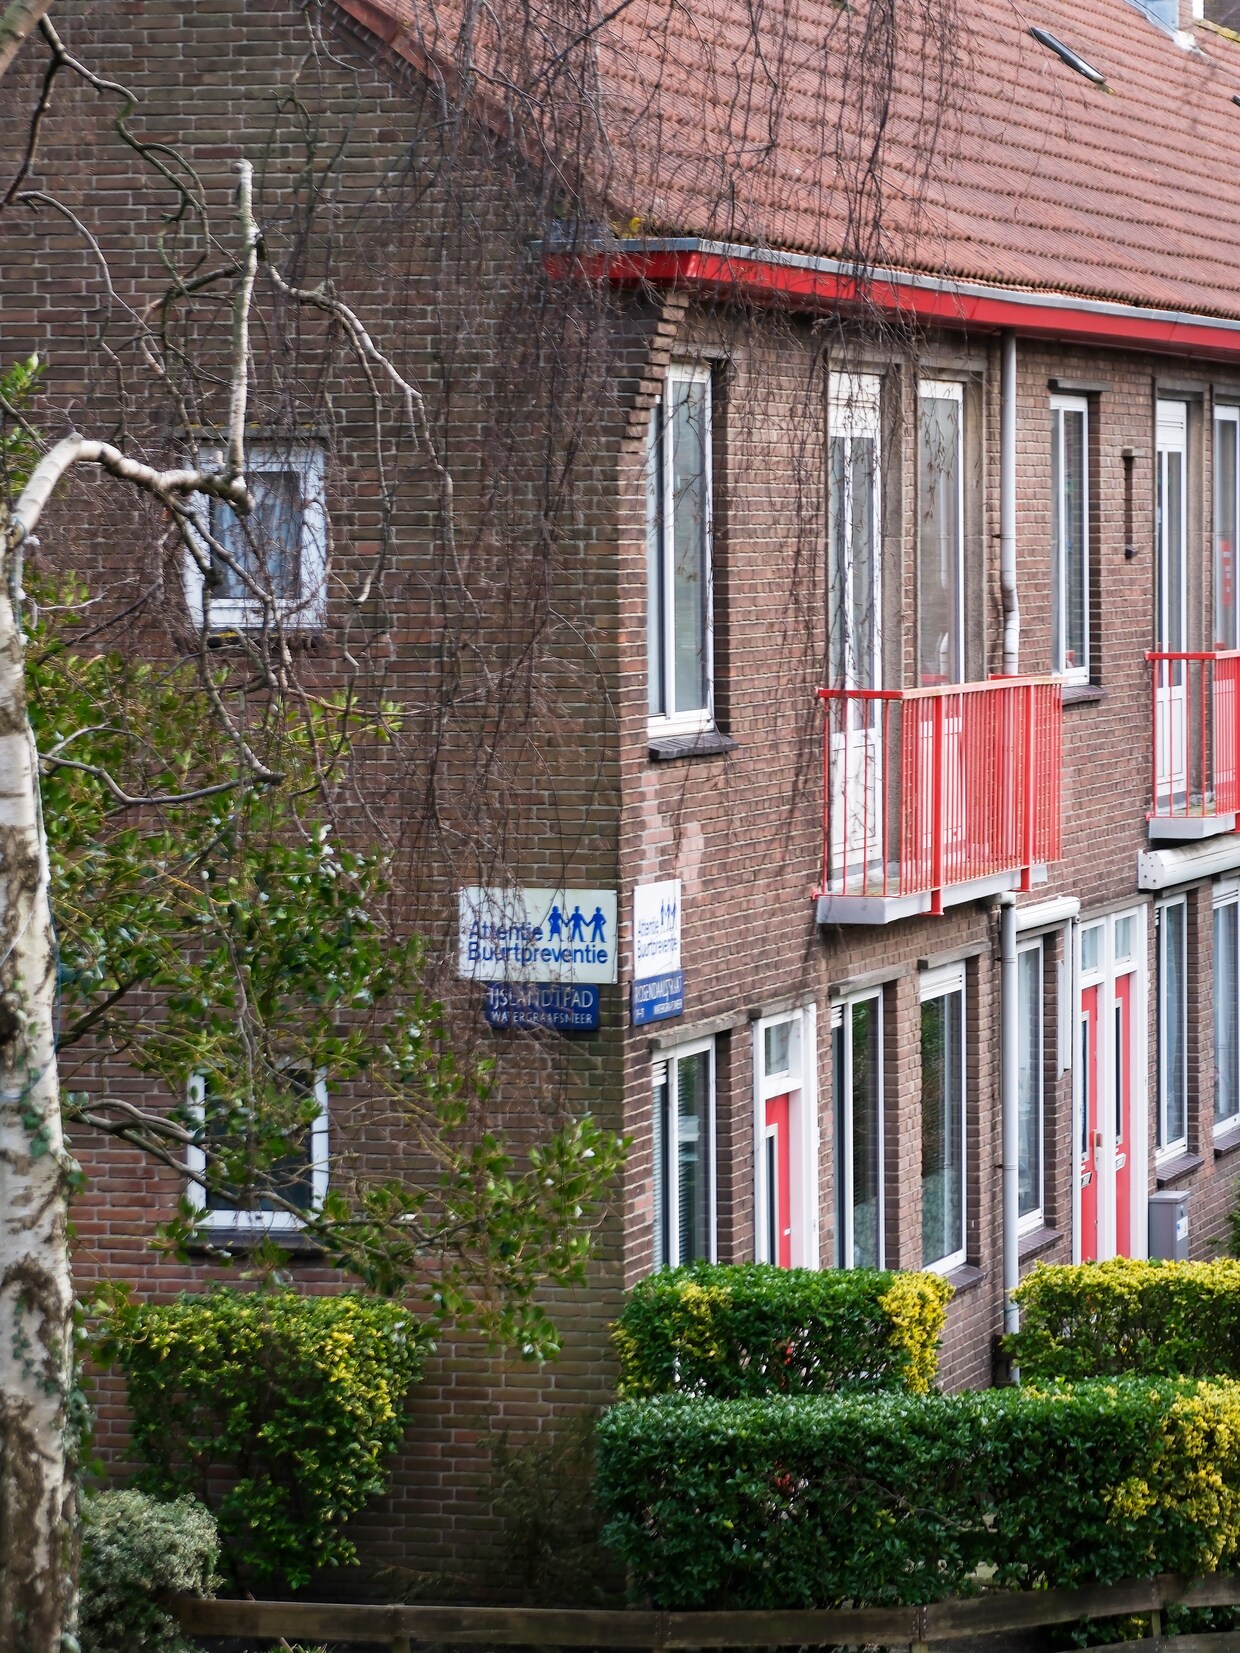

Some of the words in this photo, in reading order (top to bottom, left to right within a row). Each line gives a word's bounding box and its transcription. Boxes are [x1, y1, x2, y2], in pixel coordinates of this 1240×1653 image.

[469, 920, 544, 941] Attentie
[468, 941, 609, 966] Buurtpreventie
[491, 1010, 593, 1025] WAERGRAAFSMEER
